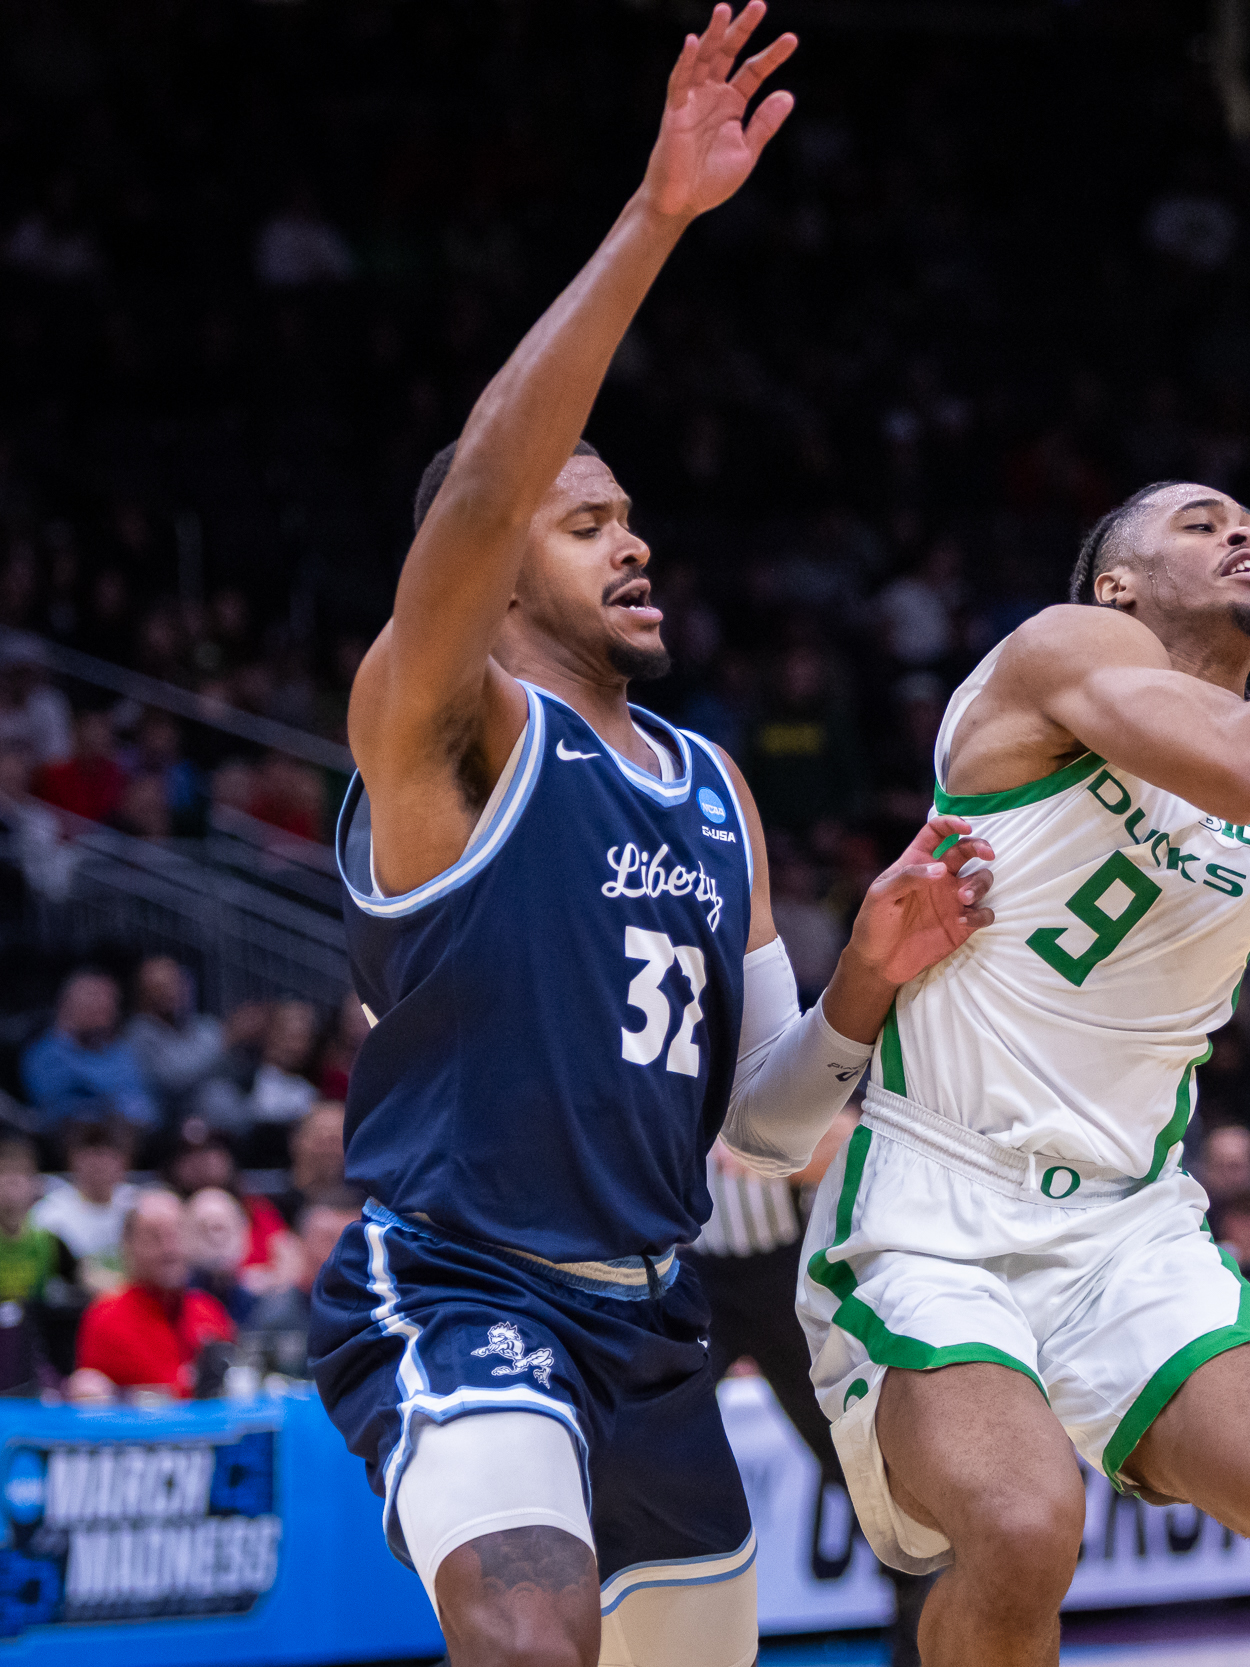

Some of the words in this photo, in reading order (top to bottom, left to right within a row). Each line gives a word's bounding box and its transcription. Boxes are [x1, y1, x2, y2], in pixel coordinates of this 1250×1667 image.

[701, 802, 725, 817] NCAA
[1086, 769, 1247, 898] DUCKS
[601, 842, 723, 933] Liberty
[1025, 850, 1163, 988] 9
[621, 926, 707, 1078] 32
[45, 1447, 213, 1520] MARCH
[67, 1514, 282, 1602] MADNESS
